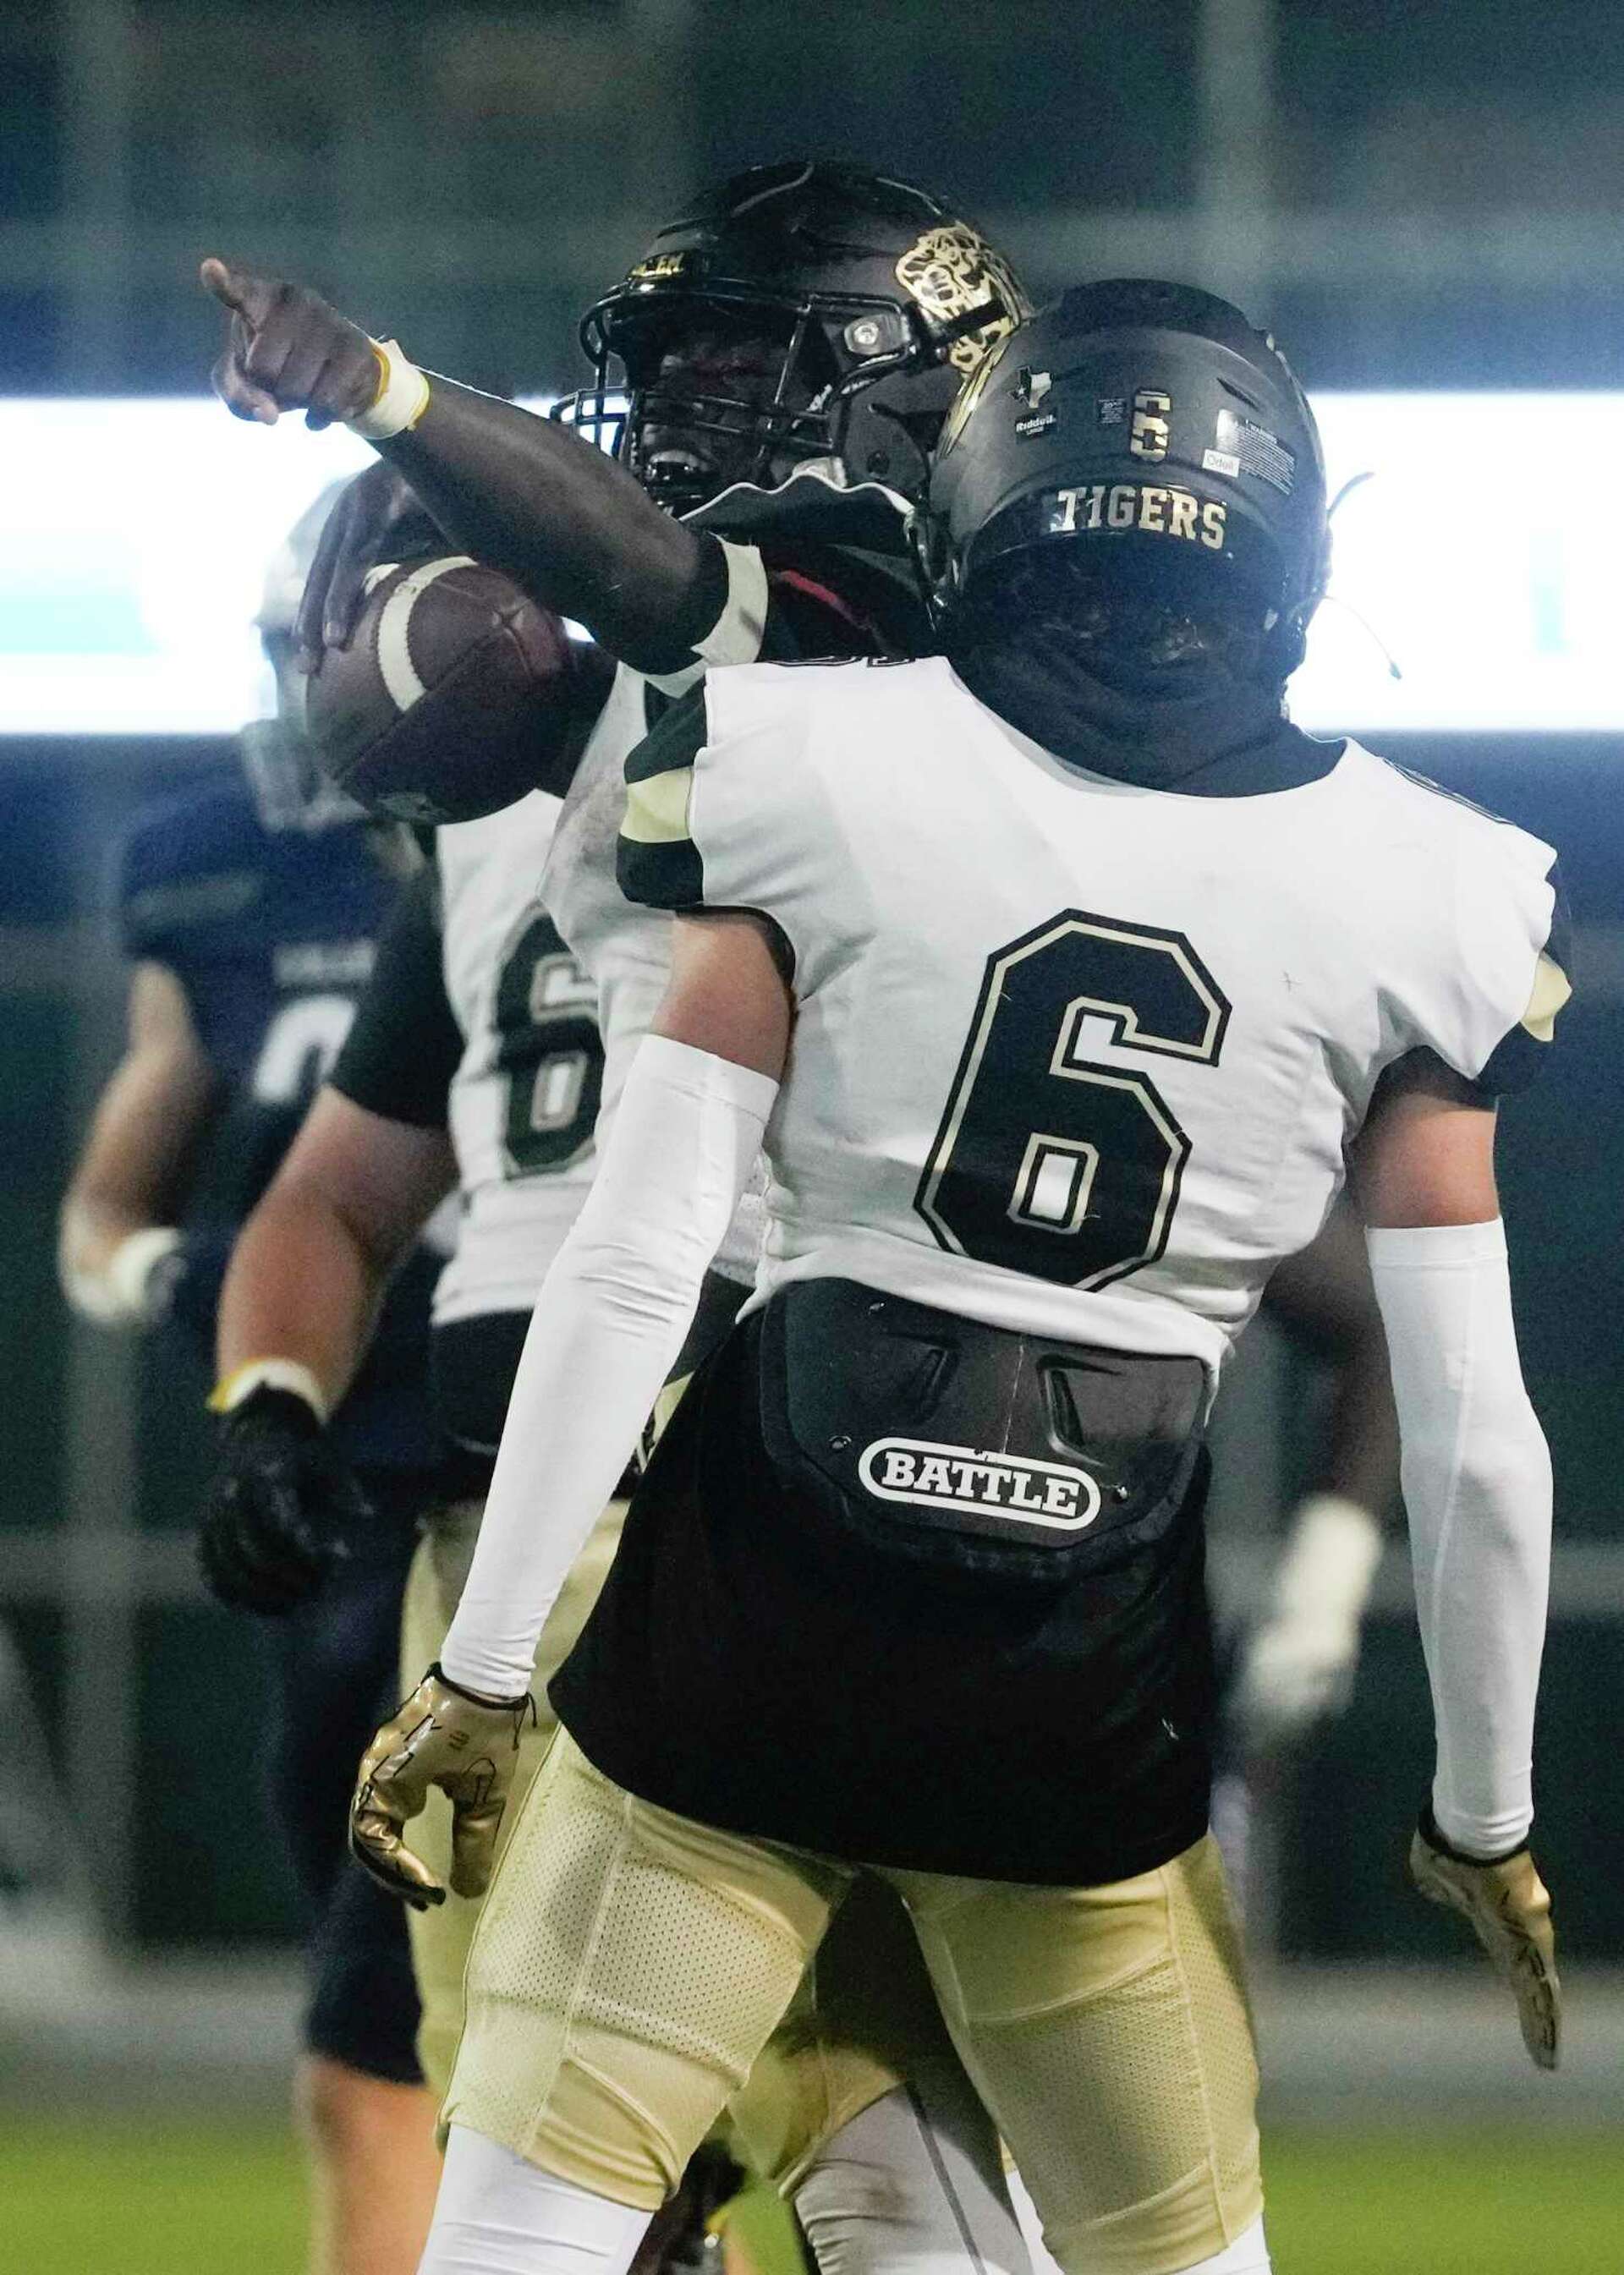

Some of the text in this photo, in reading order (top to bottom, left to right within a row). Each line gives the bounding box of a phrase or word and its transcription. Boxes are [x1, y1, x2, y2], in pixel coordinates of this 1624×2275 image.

[1050, 485, 1226, 550] TIGERS
[497, 899, 606, 1181] 6
[914, 908, 1232, 1291] 6
[881, 1451, 1079, 1517] BATTLE
